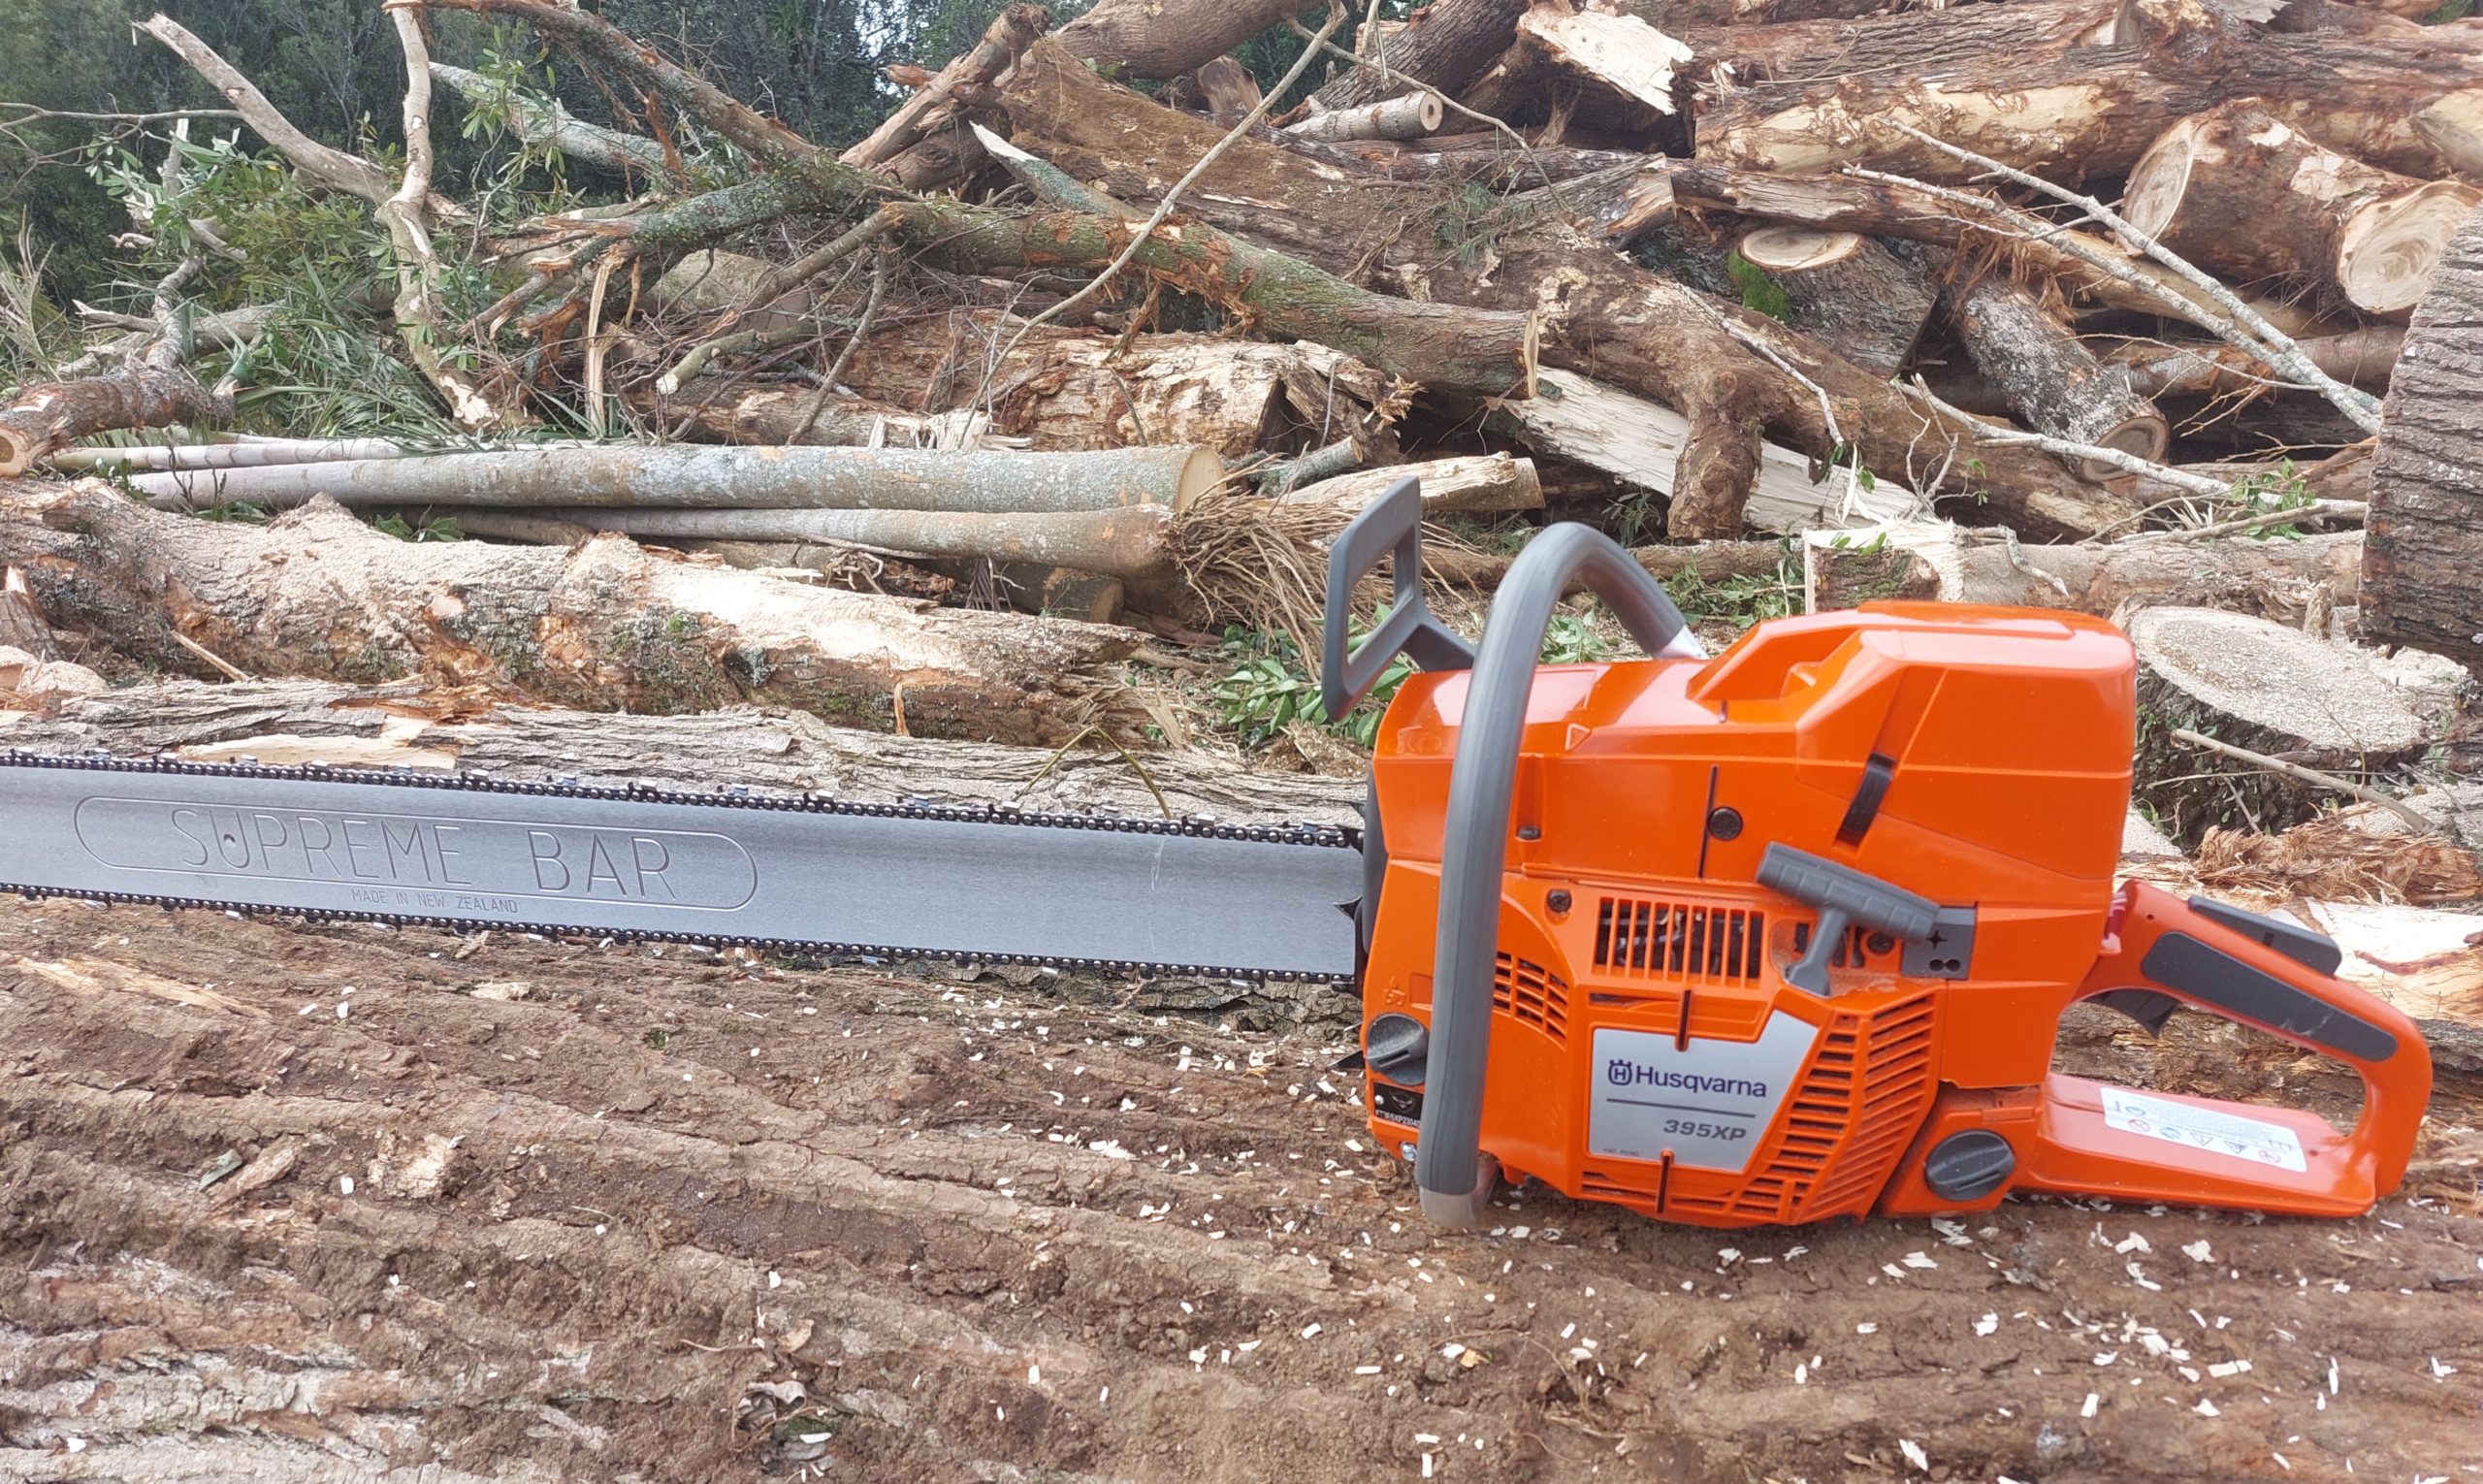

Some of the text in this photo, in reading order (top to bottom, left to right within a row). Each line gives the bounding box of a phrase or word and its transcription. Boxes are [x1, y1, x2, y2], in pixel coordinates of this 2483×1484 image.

[171, 808, 677, 901] SUPREME BAR
[351, 888, 519, 914] MADE IN NEW ZEALAND
[1634, 1065, 1768, 1098] Husqvarna
[1662, 1118, 1748, 1142] 395XP
